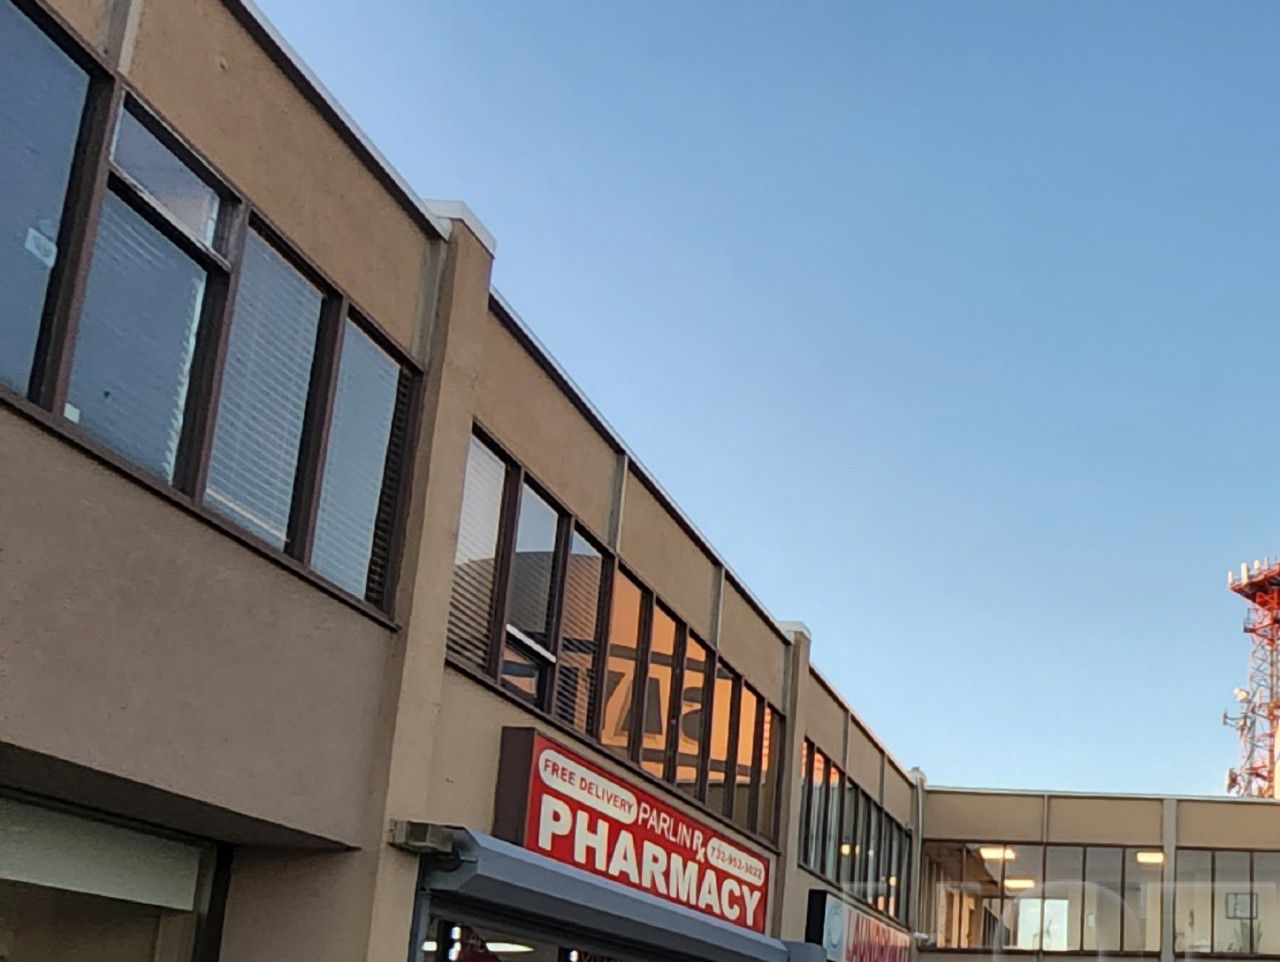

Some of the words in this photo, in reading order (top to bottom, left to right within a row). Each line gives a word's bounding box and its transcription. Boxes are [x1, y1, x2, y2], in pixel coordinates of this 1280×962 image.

[543, 758, 576, 786] FREE
[580, 777, 634, 816] DELIVERY
[638, 802, 692, 851] PARLIN
[538, 793, 762, 927] PHARMACY
